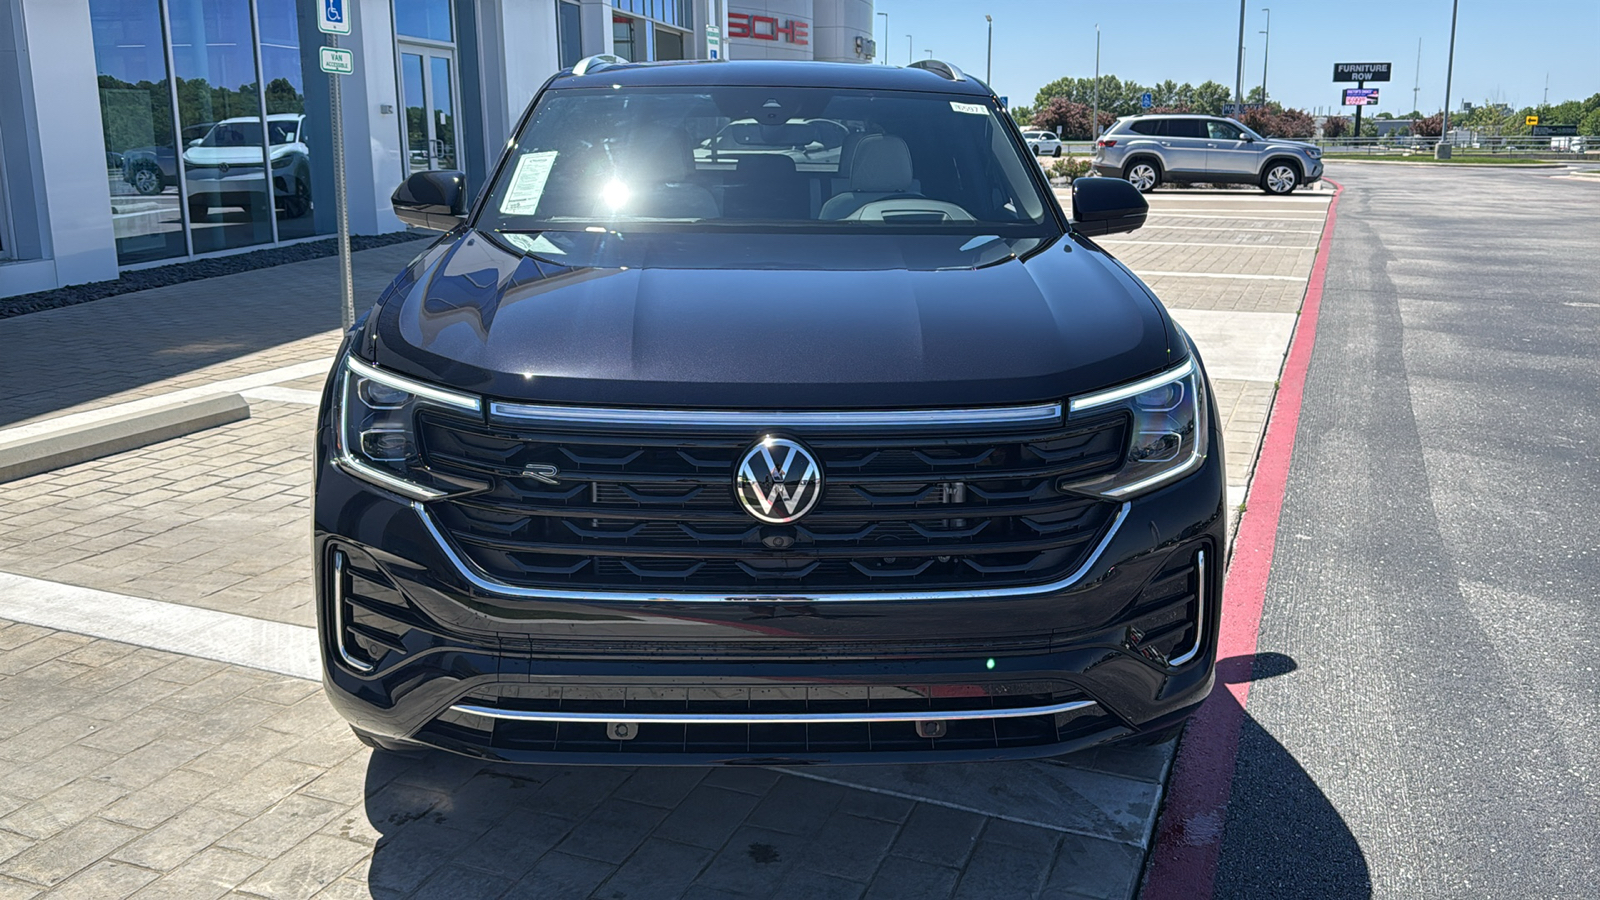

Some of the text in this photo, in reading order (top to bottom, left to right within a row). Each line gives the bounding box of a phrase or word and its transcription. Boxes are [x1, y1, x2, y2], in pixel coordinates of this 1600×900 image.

[331, 53, 343, 62] VAN
[1338, 64, 1388, 72] FURNITURE
[1351, 72, 1373, 80] ROW
[522, 463, 560, 485] R
[740, 443, 817, 517] VW
